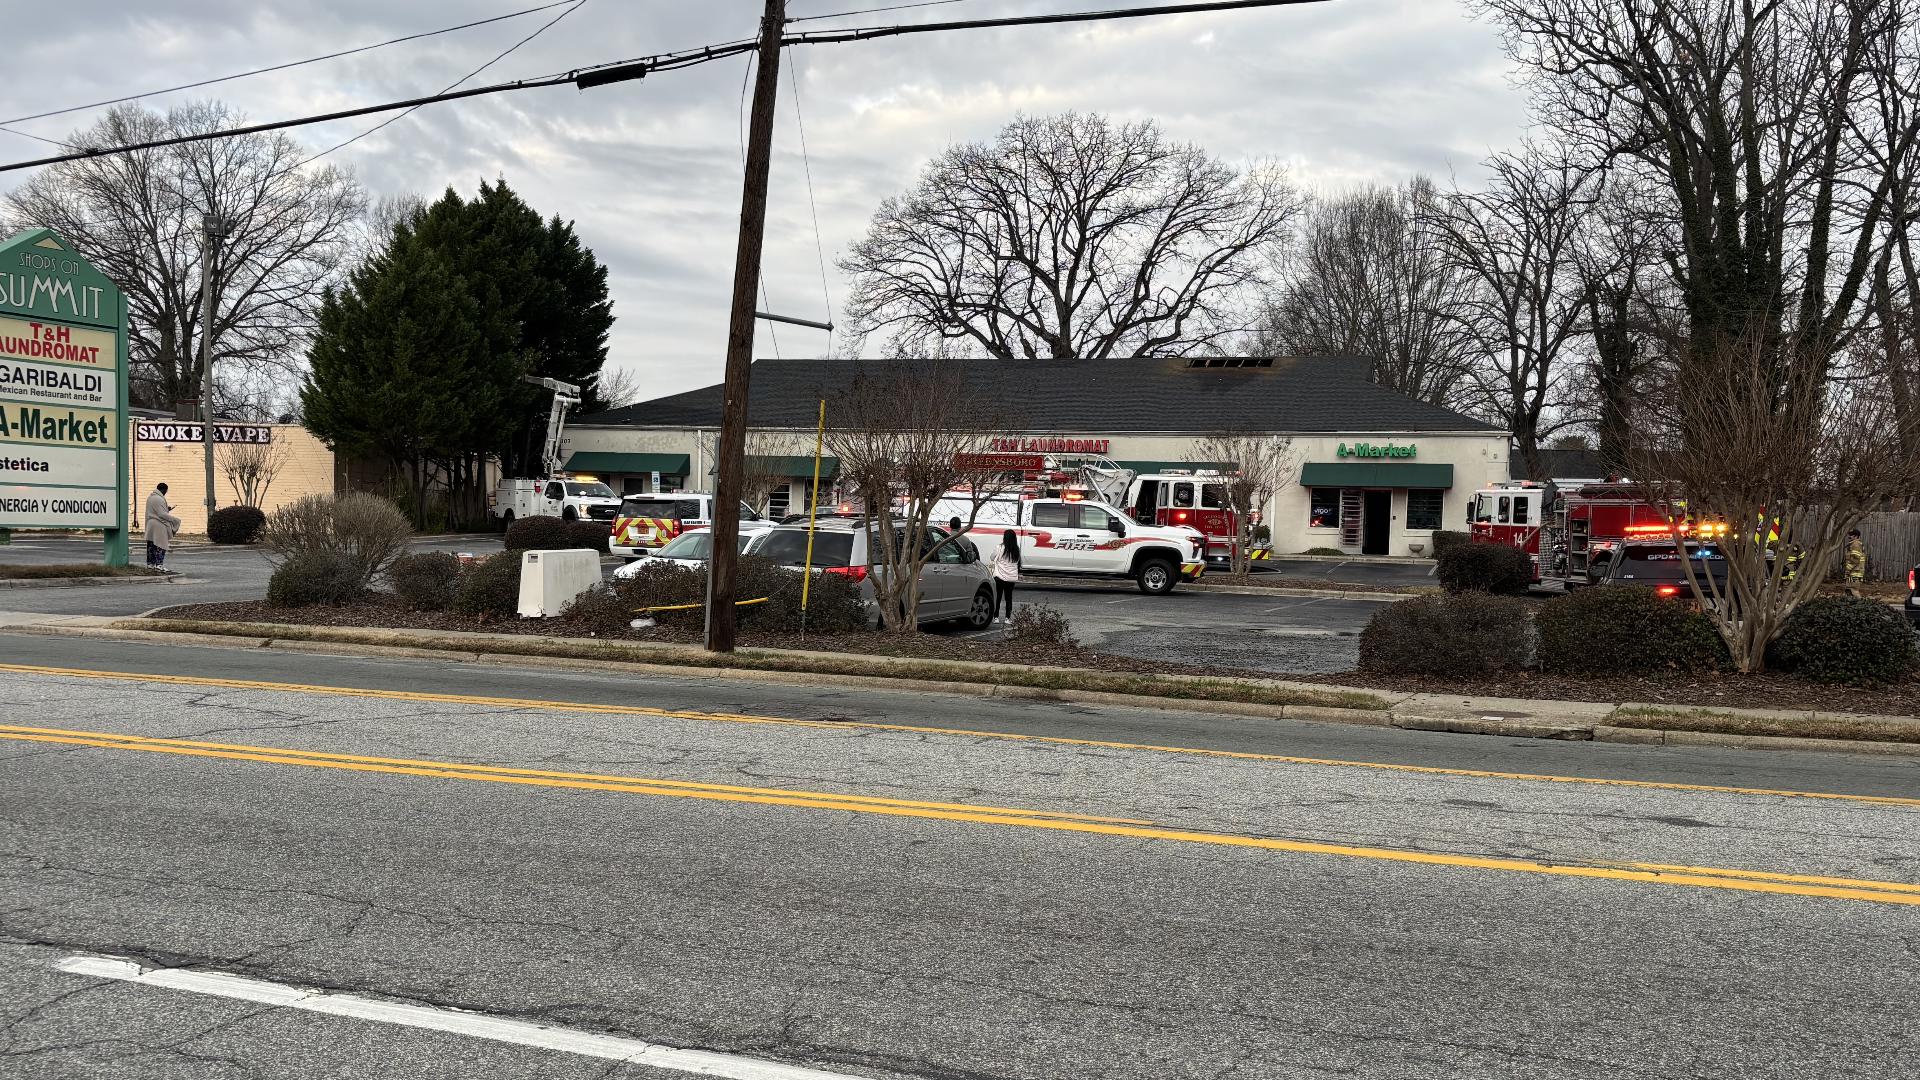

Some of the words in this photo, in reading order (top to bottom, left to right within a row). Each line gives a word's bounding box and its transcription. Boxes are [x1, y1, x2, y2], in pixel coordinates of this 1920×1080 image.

[19, 252, 57, 272] SHOPS
[60, 260, 79, 275] ON
[0, 272, 104, 319] SUMMIT
[0, 364, 102, 392] GARIBALDI
[30, 388, 72, 400] Restaurant
[73, 392, 88, 401] and
[89, 394, 102, 402] Bar
[0, 405, 108, 444] A-Market
[137, 425, 203, 441] SMOKE
[219, 427, 270, 443] VAPE
[1020, 438, 1110, 453] LAUNDROMAT
[1336, 443, 1417, 458] A-Market
[0, 456, 49, 472] stetica
[0, 498, 39, 513] NERGIA
[41, 499, 49, 513] Y
[51, 499, 107, 514] CONDICION
[1054, 542, 1097, 551] FIRE
